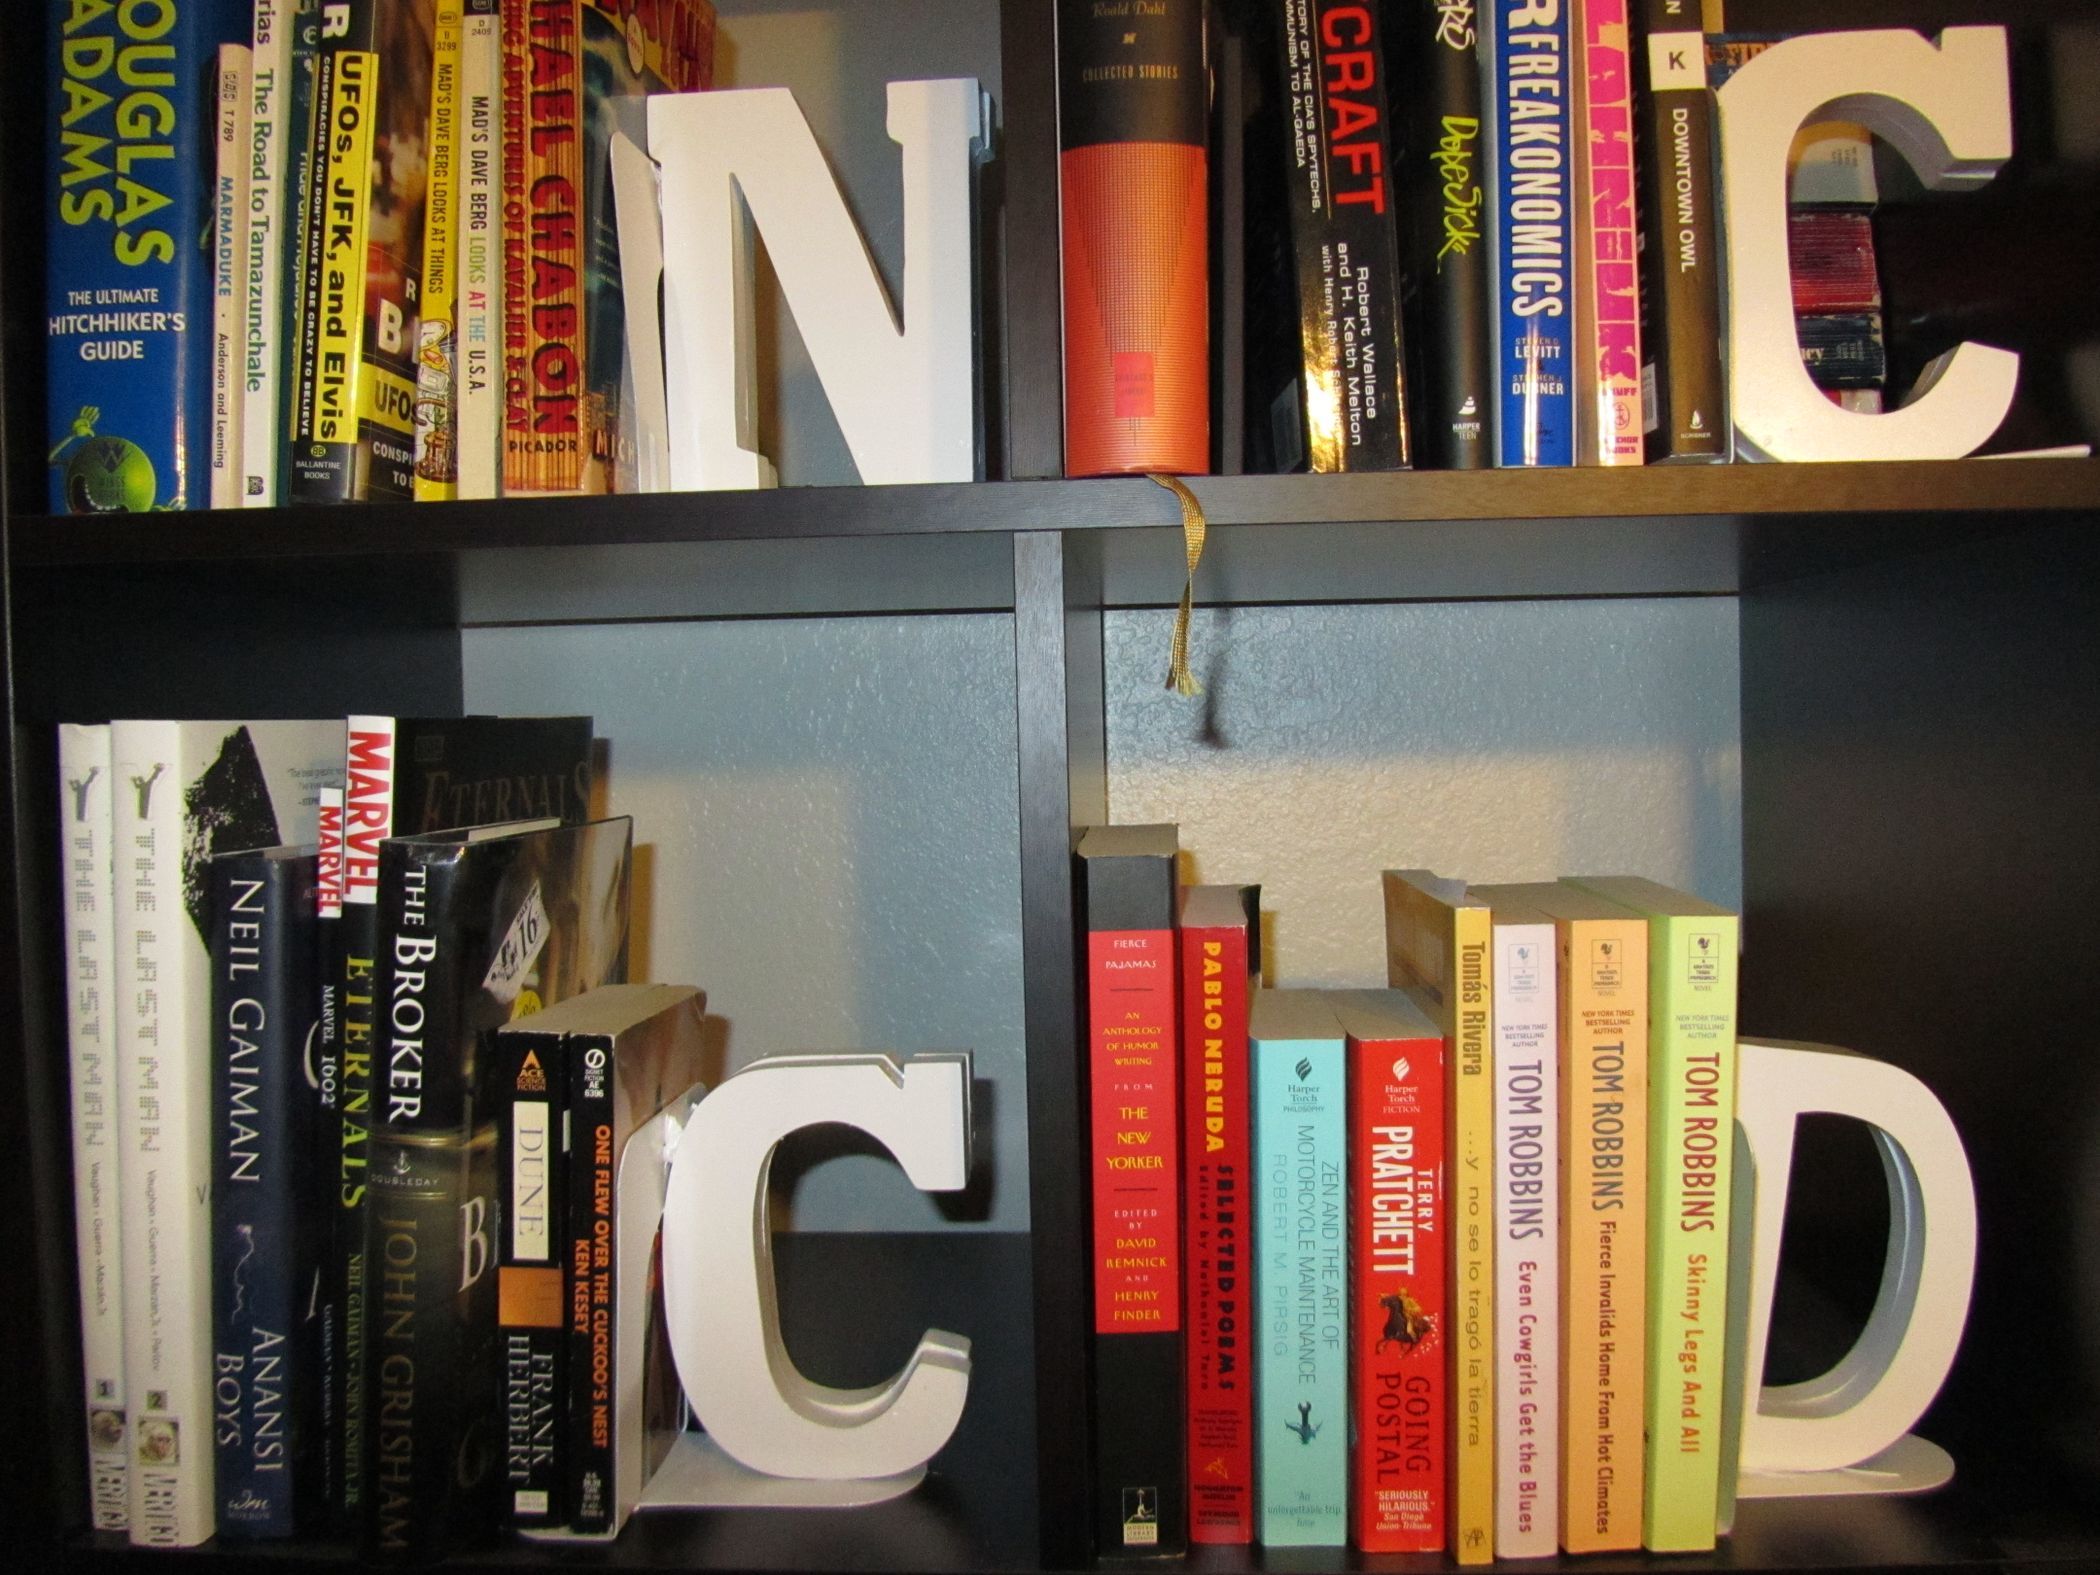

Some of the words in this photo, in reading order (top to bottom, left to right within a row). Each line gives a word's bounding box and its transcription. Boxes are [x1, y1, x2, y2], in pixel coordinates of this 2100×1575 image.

[254, 68, 275, 114] The
[436, 64, 453, 104] MAD'S
[1082, 66, 1134, 81] COLLECTED
[1138, 64, 1178, 80] STORIES
[317, 56, 332, 151] CONSPIRACIES
[333, 55, 363, 164] UFOs,
[435, 108, 451, 142] DAVE
[471, 96, 489, 143] MAD'S
[1321, 7, 1386, 215] CRAFT
[252, 120, 274, 181] Road
[315, 156, 329, 182] YOU
[434, 145, 449, 178] BERG
[470, 150, 488, 187] DAVE
[1672, 107, 1694, 224] DOWNTOWN
[1507, 34, 1562, 318] FREAKONOMICS
[250, 187, 268, 213] to
[313, 187, 327, 226] DON'T
[326, 177, 356, 260] JFK,
[431, 183, 448, 224] LOOKS
[470, 193, 487, 231] BERG
[216, 176, 234, 297] MARMADUKE
[311, 231, 325, 264] HAVE
[430, 228, 445, 244] AT
[1680, 229, 1698, 273] OWL
[310, 270, 322, 286] TO
[429, 248, 445, 294] THINGS
[469, 236, 486, 284] LOOKS
[1337, 242, 1352, 278] and
[67, 291, 92, 306] THE
[94, 287, 159, 305] ULTIMATE
[246, 215, 271, 393] Tamazunchale
[308, 290, 321, 307] BE
[329, 270, 348, 339] and
[468, 290, 486, 311] AT
[1340, 285, 1354, 308] H.
[1355, 266, 1372, 337] Robert
[49, 312, 186, 336] HITCHHIKER'S
[306, 311, 319, 354] CRAZY
[468, 315, 486, 343] THE
[1343, 316, 1358, 369] Keith
[80, 340, 144, 362] GUIDE
[216, 333, 230, 388] Anderson
[304, 360, 316, 377] TO
[468, 350, 486, 396] U.S.A.
[217, 393, 229, 416] and
[320, 352, 346, 440] Elvis
[1361, 343, 1378, 420] Wallace
[301, 381, 316, 436] BELIEVE
[1347, 376, 1363, 446] Melton
[1452, 423, 1481, 432] HARPER
[213, 419, 228, 469] Leeming
[508, 439, 579, 454] PICADOR
[304, 471, 331, 480] BOOKS
[344, 731, 392, 896] MARVEL
[75, 830, 96, 912] THE
[135, 828, 156, 912] THE
[318, 806, 342, 913] MARVEL
[402, 864, 428, 926] THE
[229, 878, 266, 980] NEIL
[1113, 938, 1148, 948] FIERCE
[77, 930, 100, 1043] LAST
[1104, 959, 1158, 970] PAJAMAS
[1203, 942, 1223, 1030] PABLO
[1461, 940, 1487, 1003] Tomás
[136, 930, 158, 1047] LAST
[387, 933, 439, 1124] BROKER
[1101, 1025, 1163, 1037] ANTHOLOGY
[1124, 1010, 1141, 1020] AN
[1504, 1032, 1545, 1040] BESTSELLING
[1581, 1010, 1594, 1018] NEW
[1595, 1010, 1614, 1018] YORK
[1615, 1009, 1635, 1018] TIMES
[1585, 1018, 1631, 1027] BESTSELLING
[1592, 1027, 1624, 1036] AUTHOR
[1679, 1022, 1725, 1031] BESTSELLING
[1687, 1031, 1717, 1039] AUTHOR
[1105, 1042, 1121, 1052] OF
[1123, 1041, 1160, 1052] HUMOR
[1113, 1056, 1153, 1067] WRITING
[1461, 1009, 1485, 1075] Rivera
[1511, 1040, 1538, 1048] AUTHOR
[341, 954, 375, 1208] ETERNALS
[1113, 1083, 1154, 1091] FROM
[1287, 1084, 1320, 1093] Harper
[1385, 1084, 1419, 1094] Harper
[1508, 1059, 1543, 1115] TOM
[1591, 1040, 1624, 1093] TOM
[1684, 1052, 1720, 1107] TOM
[82, 1053, 105, 1146] MAN
[138, 1056, 160, 1152] MAN
[228, 997, 266, 1183] GAIMAN
[1204, 1038, 1224, 1153] NERUDA
[1289, 1094, 1318, 1102] Torch
[1386, 1094, 1416, 1103] Torch
[1119, 1106, 1149, 1121] THE
[593, 1124, 612, 1164] ONE
[1116, 1130, 1153, 1145] NEW
[1591, 1101, 1624, 1211] ROBBINS
[518, 1128, 545, 1235] DUNE
[1105, 1155, 1164, 1171] YORKER
[1321, 1160, 1339, 1196] ZEN
[1508, 1124, 1543, 1240] ROBBINS
[1679, 1116, 1718, 1232] ROBBINS
[592, 1169, 611, 1216] FLEW
[1297, 1125, 1316, 1251] MOTORCYCLE
[1371, 1125, 1414, 1276] PRATCHETT
[1417, 1168, 1434, 1232] TERRY
[1113, 1208, 1158, 1219] EDITED
[1128, 1221, 1143, 1231] BY
[1217, 1165, 1235, 1292] SELECTED
[1321, 1200, 1339, 1240] AND
[574, 1239, 591, 1277] KEN
[593, 1219, 611, 1267] OVER
[1105, 1256, 1169, 1269] REMNICK
[1115, 1236, 1157, 1248] DAVID
[1321, 1244, 1339, 1280] THE
[1599, 1221, 1617, 1269] Fierce
[376, 1215, 419, 1342] JOHN
[592, 1272, 610, 1304] THE
[1114, 1290, 1160, 1303] HENRY
[1125, 1274, 1150, 1282] AND
[1518, 1260, 1537, 1308] Even
[1680, 1253, 1707, 1321] Skinny
[572, 1280, 590, 1335] KESEY
[1113, 1308, 1162, 1321] FINDER
[1297, 1256, 1316, 1384] MAINTENANCE
[1321, 1283, 1338, 1320] ART
[1598, 1273, 1616, 1338] Invalids
[591, 1309, 610, 1399] CUCKOO'S
[1217, 1301, 1235, 1390] POEMS
[1321, 1324, 1338, 1351] OF
[1513, 1313, 1537, 1396] Cowgirls
[1679, 1328, 1704, 1374] Legs
[1598, 1341, 1615, 1387] Home
[215, 1352, 246, 1448] BOYS
[252, 1325, 287, 1472] ANANSI
[507, 1334, 532, 1484] HERBERT
[531, 1351, 554, 1466] FRANK
[1518, 1402, 1538, 1436] Get
[1597, 1391, 1615, 1429] From
[1681, 1380, 1702, 1419] And
[591, 1404, 608, 1449] NEST
[1376, 1372, 1401, 1485] POSTAL
[1403, 1375, 1432, 1474] GOING
[1680, 1425, 1701, 1453] All
[377, 1354, 415, 1552] GRISHAM
[1519, 1442, 1537, 1474] the
[1597, 1433, 1614, 1463] Hot
[1518, 1480, 1537, 1533] Blues
[1596, 1466, 1614, 1535] Climates
